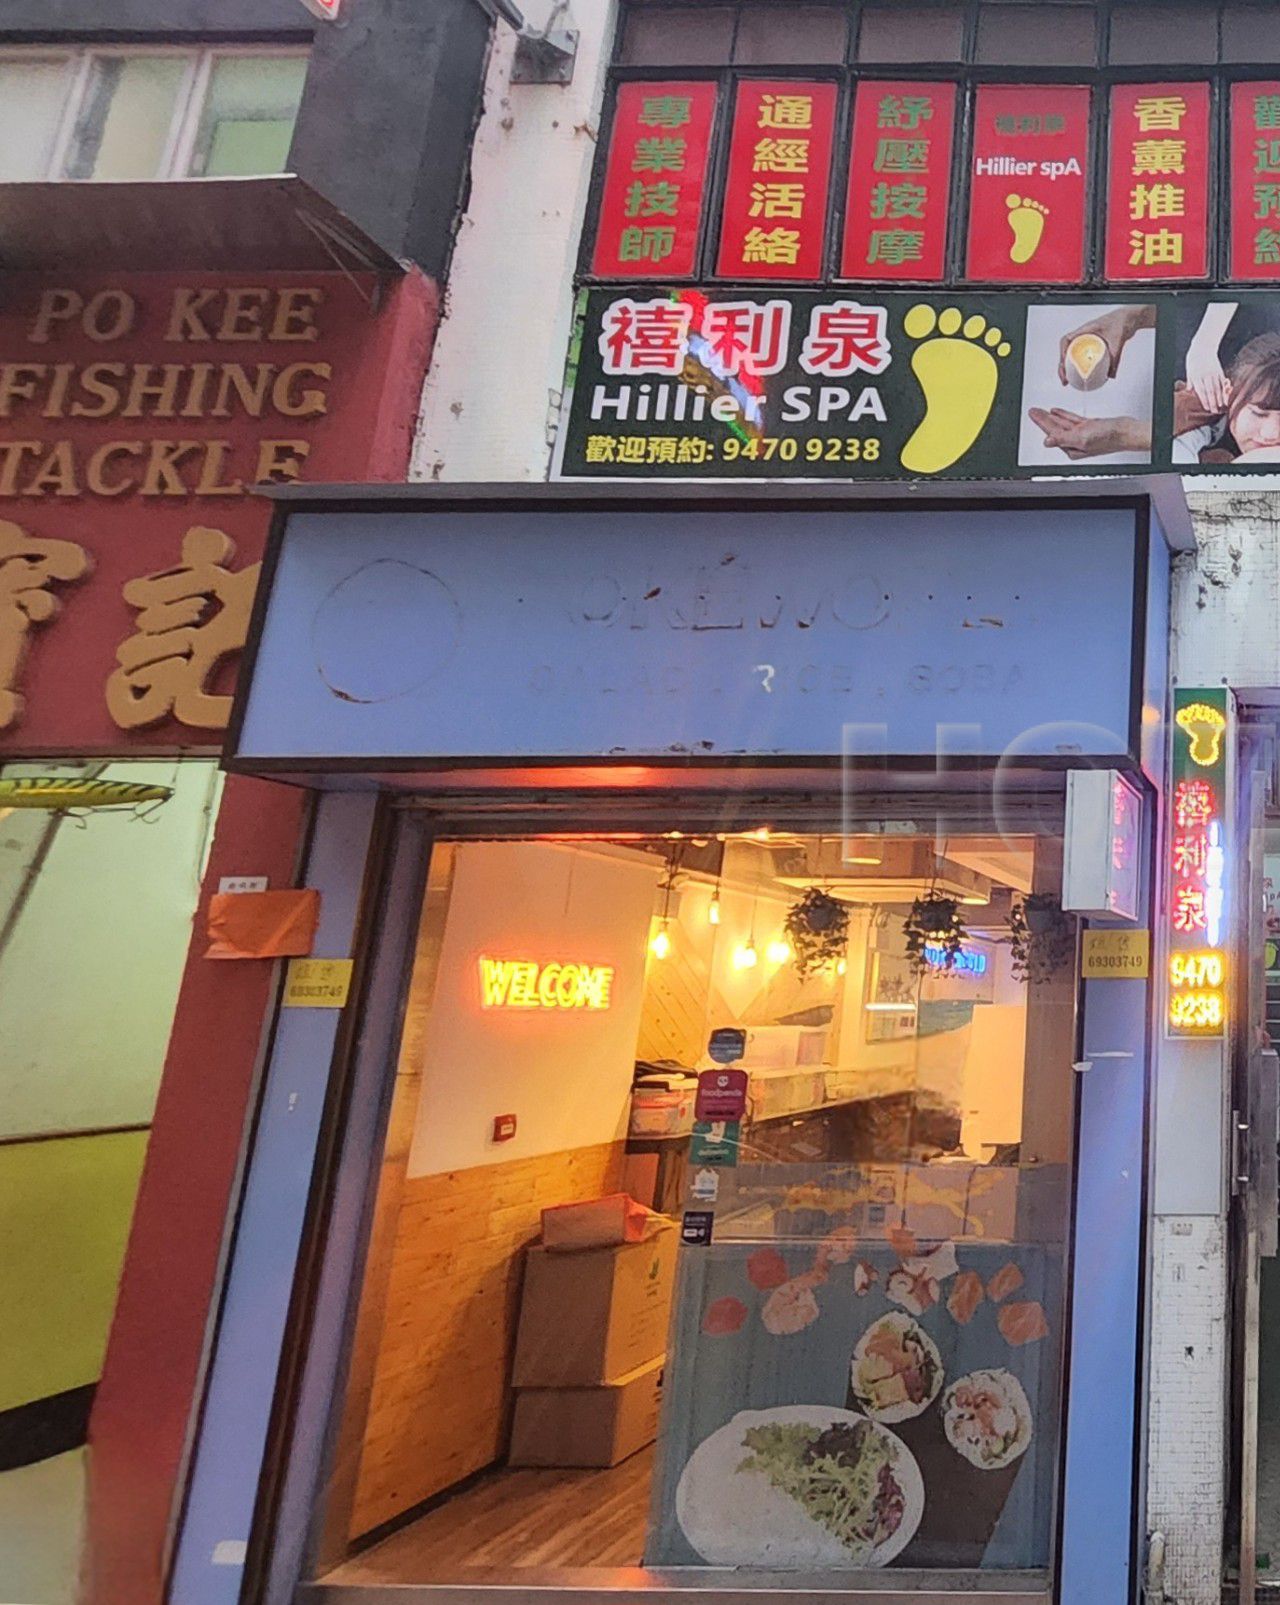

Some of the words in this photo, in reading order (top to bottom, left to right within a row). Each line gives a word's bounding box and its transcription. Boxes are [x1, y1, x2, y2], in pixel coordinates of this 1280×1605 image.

[617, 95, 694, 263] 專業技師
[742, 94, 813, 265] 通經活絡
[866, 95, 934, 266] 紓壓按摩
[976, 157, 1037, 176] Hillier
[1128, 96, 1187, 266] 香薰推油
[28, 287, 135, 344] PO
[164, 286, 323, 343] KEE
[602, 298, 891, 377] 禧利泉
[0, 362, 332, 418] FISHING
[590, 386, 766, 422] Hillier
[781, 386, 887, 422] SPA
[0, 439, 311, 499] TACKLE
[723, 437, 797, 461] 9470
[806, 437, 880, 461] 9238
[479, 954, 615, 1009] WELCOME
